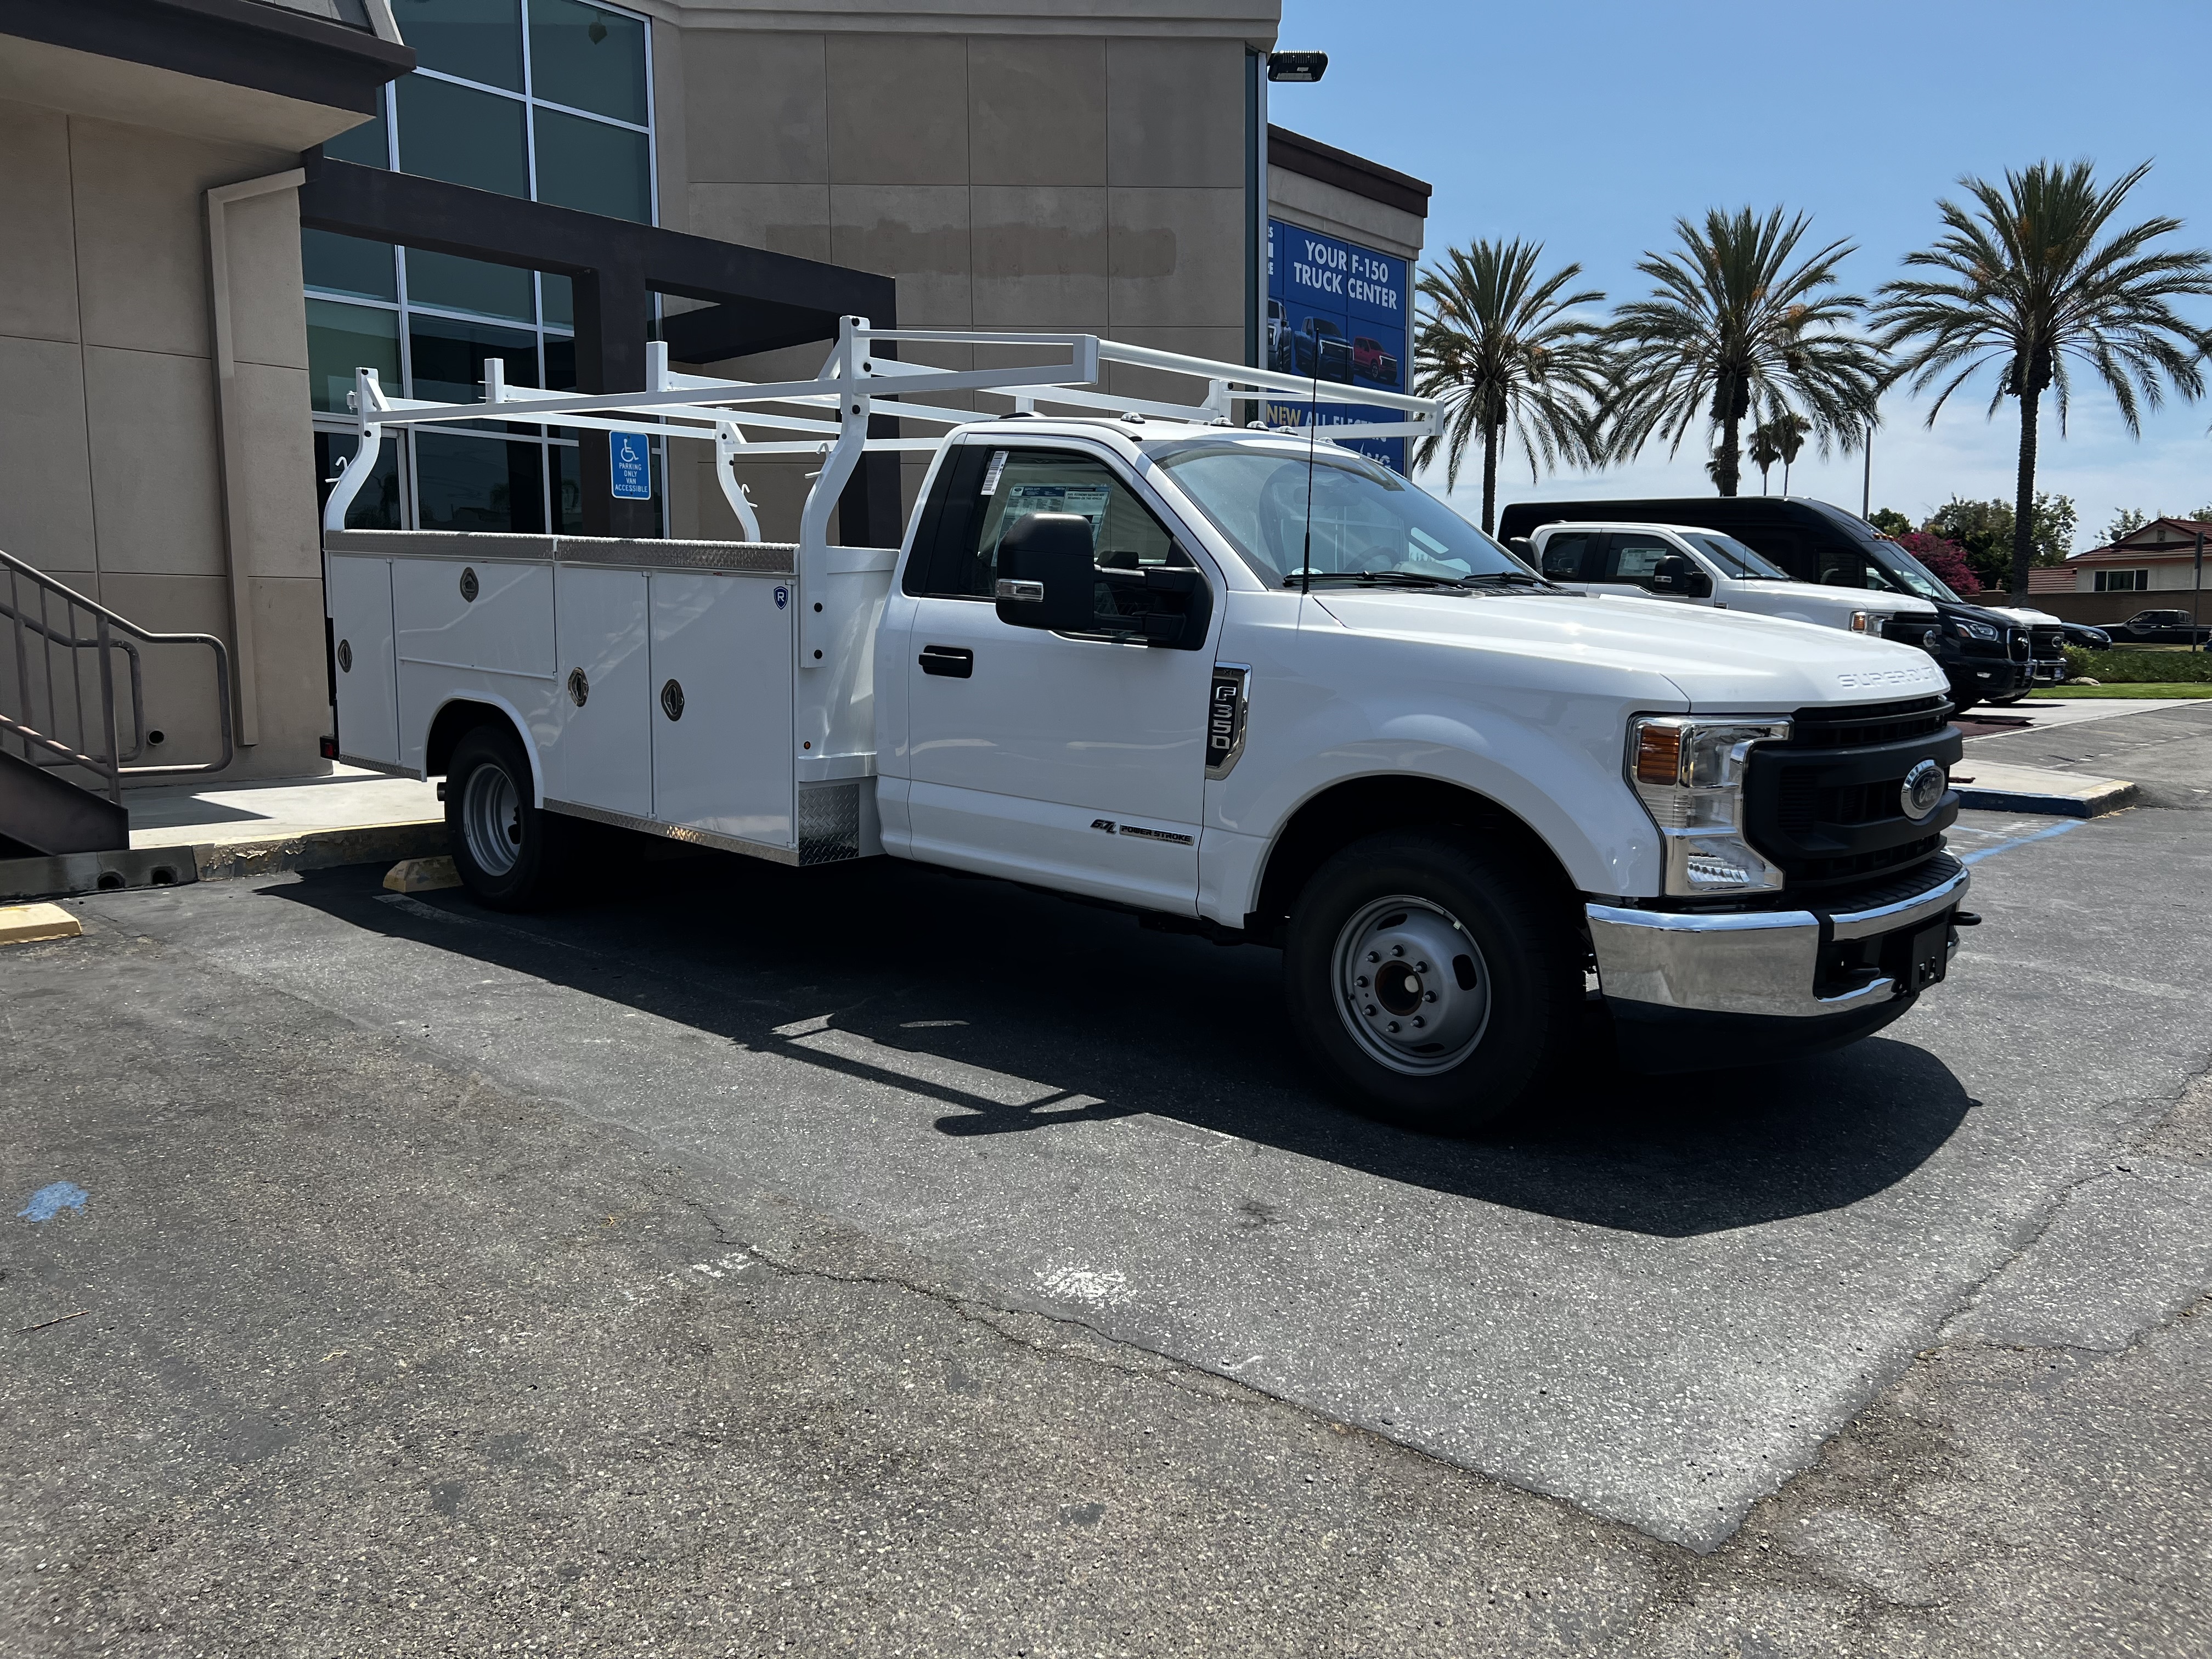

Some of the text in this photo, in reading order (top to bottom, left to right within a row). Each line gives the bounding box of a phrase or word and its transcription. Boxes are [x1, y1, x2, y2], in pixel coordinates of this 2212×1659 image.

[1305, 239, 1347, 272] YOUR
[1352, 254, 1389, 283] F-150
[1294, 262, 1397, 310] TRUCK CENTER
[1267, 404, 1301, 427] NEW
[777, 592, 785, 601] R
[1211, 686, 1237, 749] F350
[1121, 826, 1190, 842] POWER STROKE
